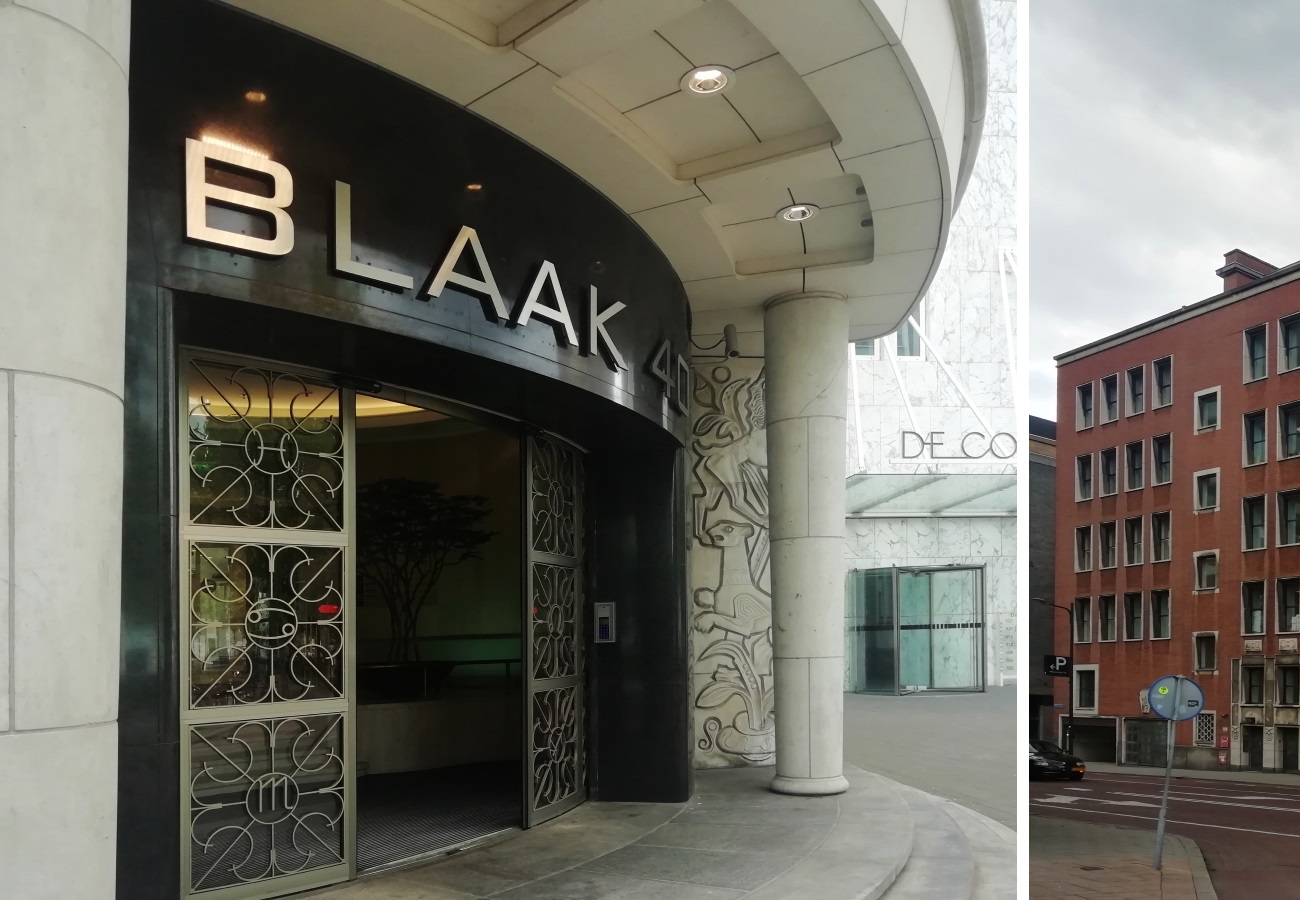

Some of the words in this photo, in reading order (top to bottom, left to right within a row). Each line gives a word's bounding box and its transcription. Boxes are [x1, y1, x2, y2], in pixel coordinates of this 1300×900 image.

[185, 137, 628, 372] BLAAK
[652, 338, 690, 418] 40
[902, 430, 945, 459] DE
[961, 431, 1017, 459] CO
[1055, 656, 1067, 671] P
